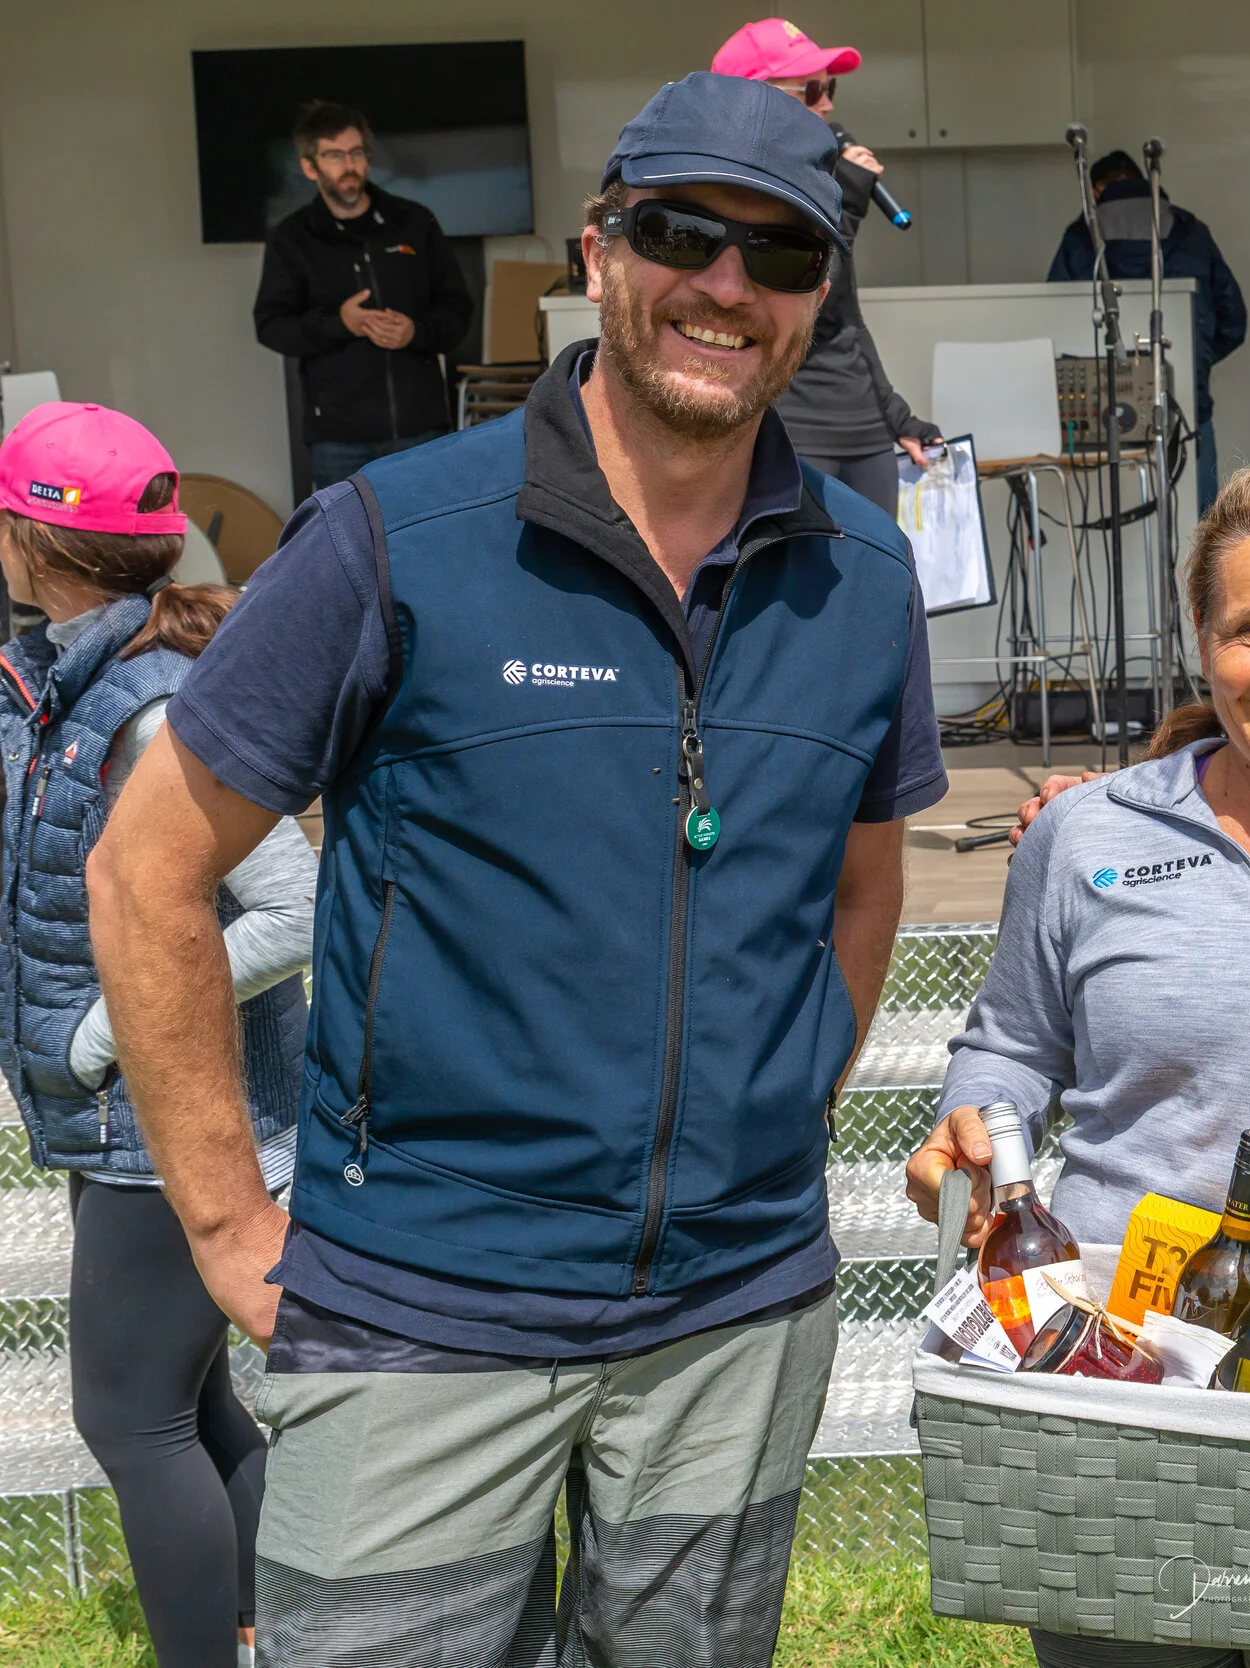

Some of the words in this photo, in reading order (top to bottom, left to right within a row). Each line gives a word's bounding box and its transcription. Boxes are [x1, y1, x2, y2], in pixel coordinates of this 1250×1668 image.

[31, 483, 62, 500] DELTA
[531, 663, 617, 681] CORTEVA
[531, 678, 575, 687] agriscience
[1124, 854, 1213, 878] CORTEVA
[1122, 872, 1182, 888] agriscience
[1142, 1235, 1188, 1275] T2
